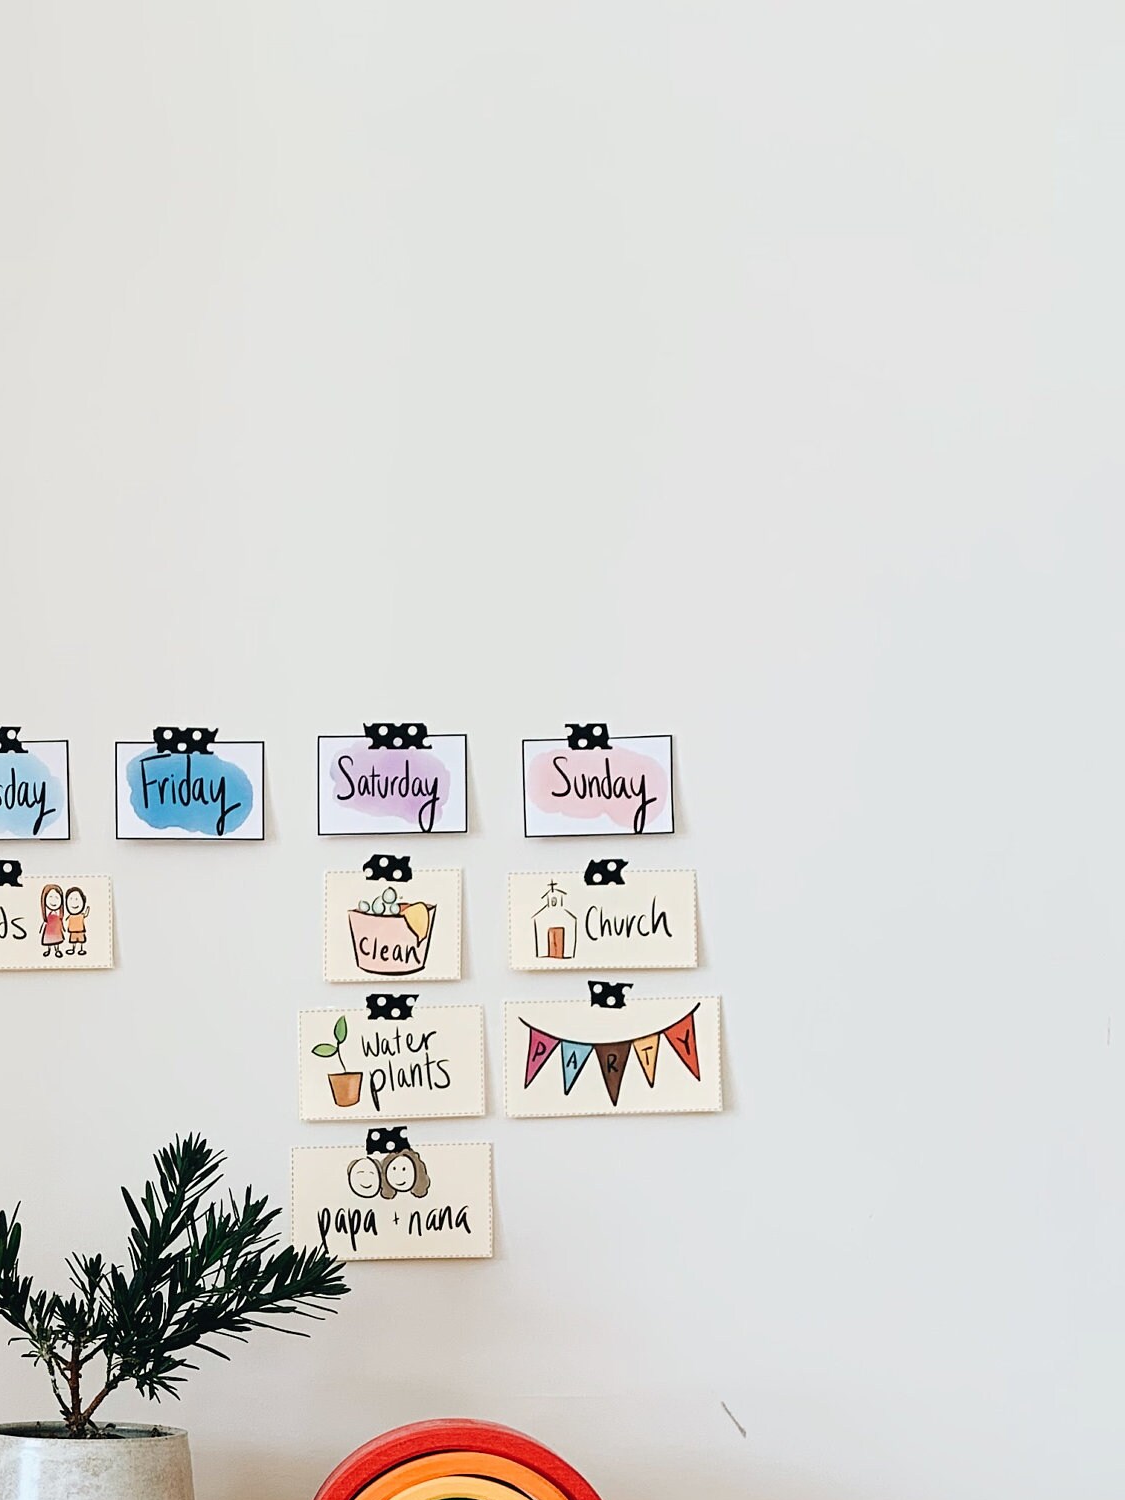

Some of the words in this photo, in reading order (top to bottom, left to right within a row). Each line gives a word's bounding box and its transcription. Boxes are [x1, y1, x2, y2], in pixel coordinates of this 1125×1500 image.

[140, 754, 242, 837] Friday
[336, 755, 440, 831] Saturday
[551, 756, 660, 835] Sunday
[585, 898, 673, 941] Church
[368, 1052, 451, 1112] plants
[314, 1207, 378, 1255] papa
[408, 1205, 472, 1237] nana
